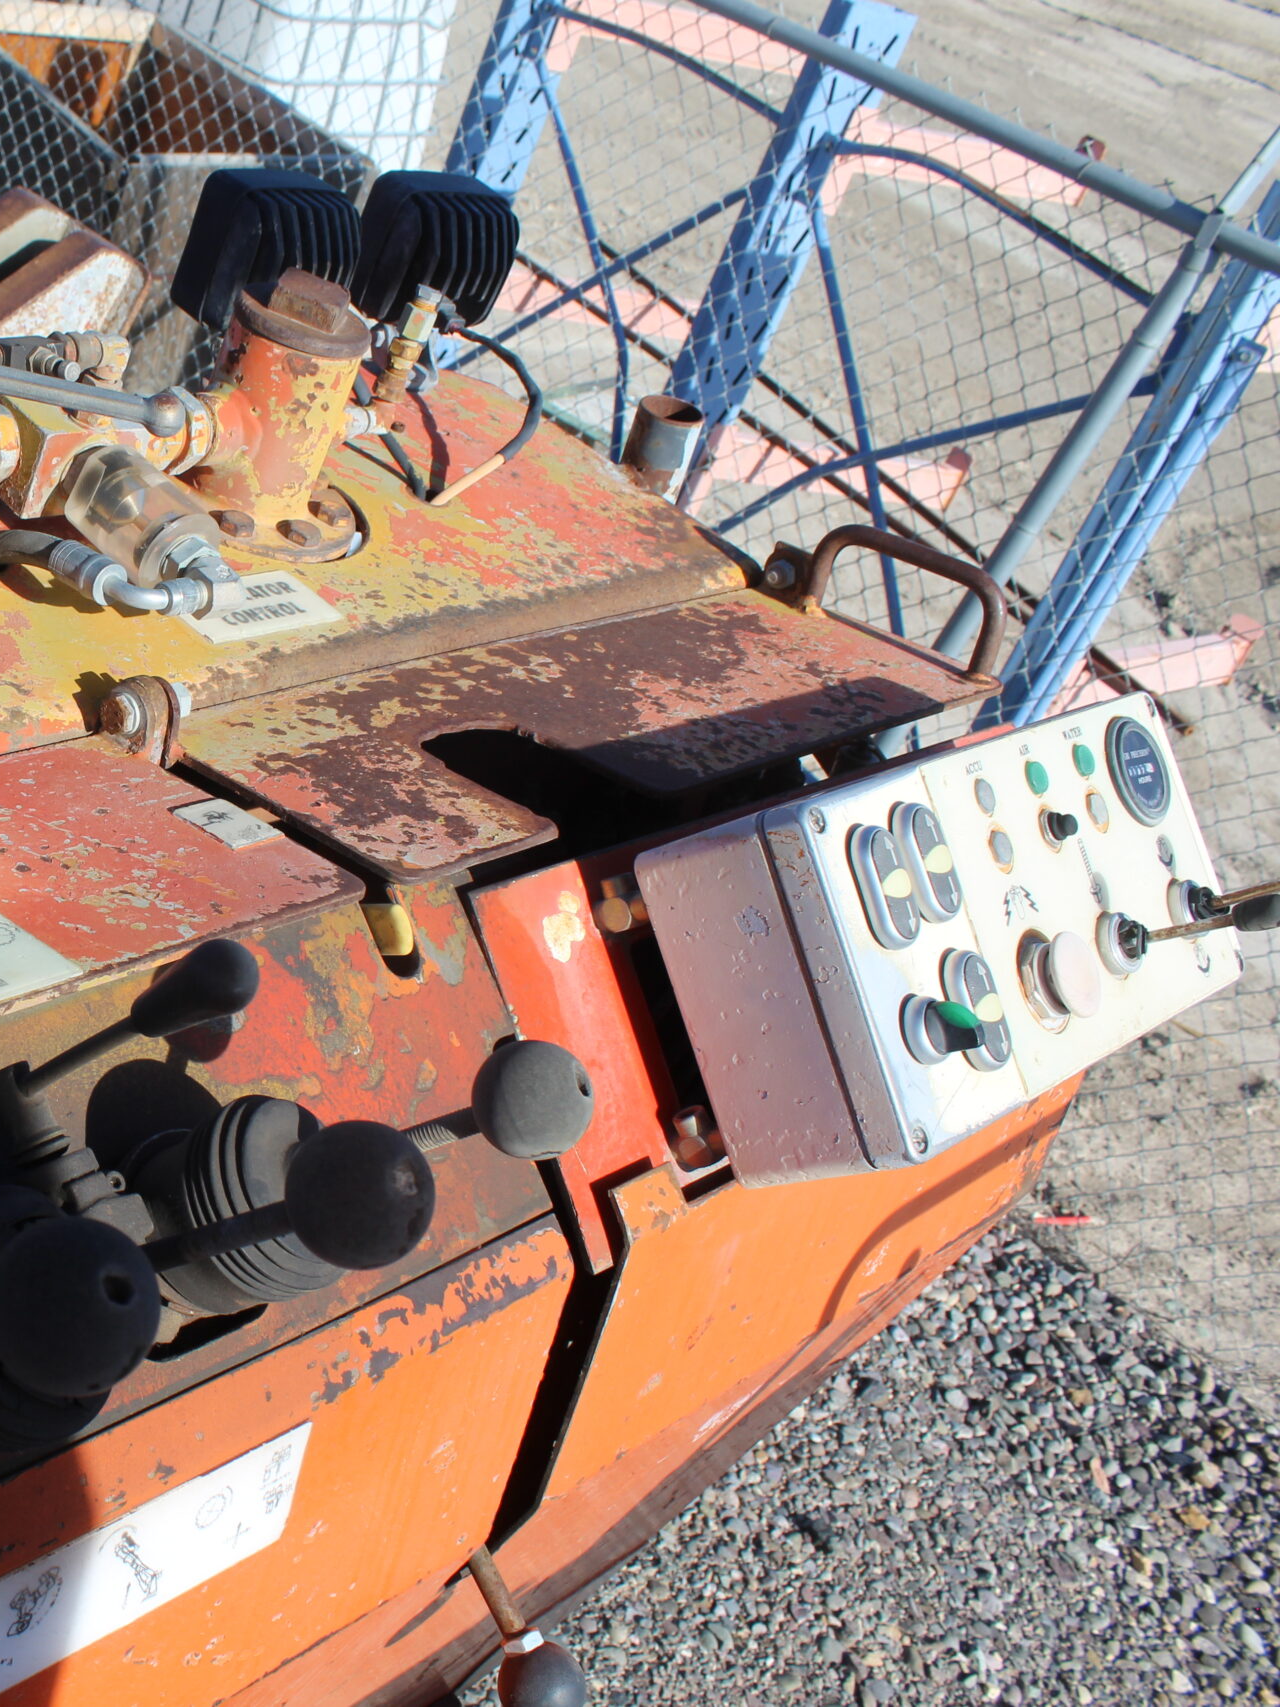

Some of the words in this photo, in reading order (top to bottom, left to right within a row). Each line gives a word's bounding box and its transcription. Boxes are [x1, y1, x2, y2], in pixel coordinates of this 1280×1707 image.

[246, 581, 297, 600] ATOR
[222, 602, 306, 625] CONTROL
[1062, 727, 1082, 739] WATER
[1018, 744, 1030, 755] AIR
[965, 761, 982, 775] ACCU
